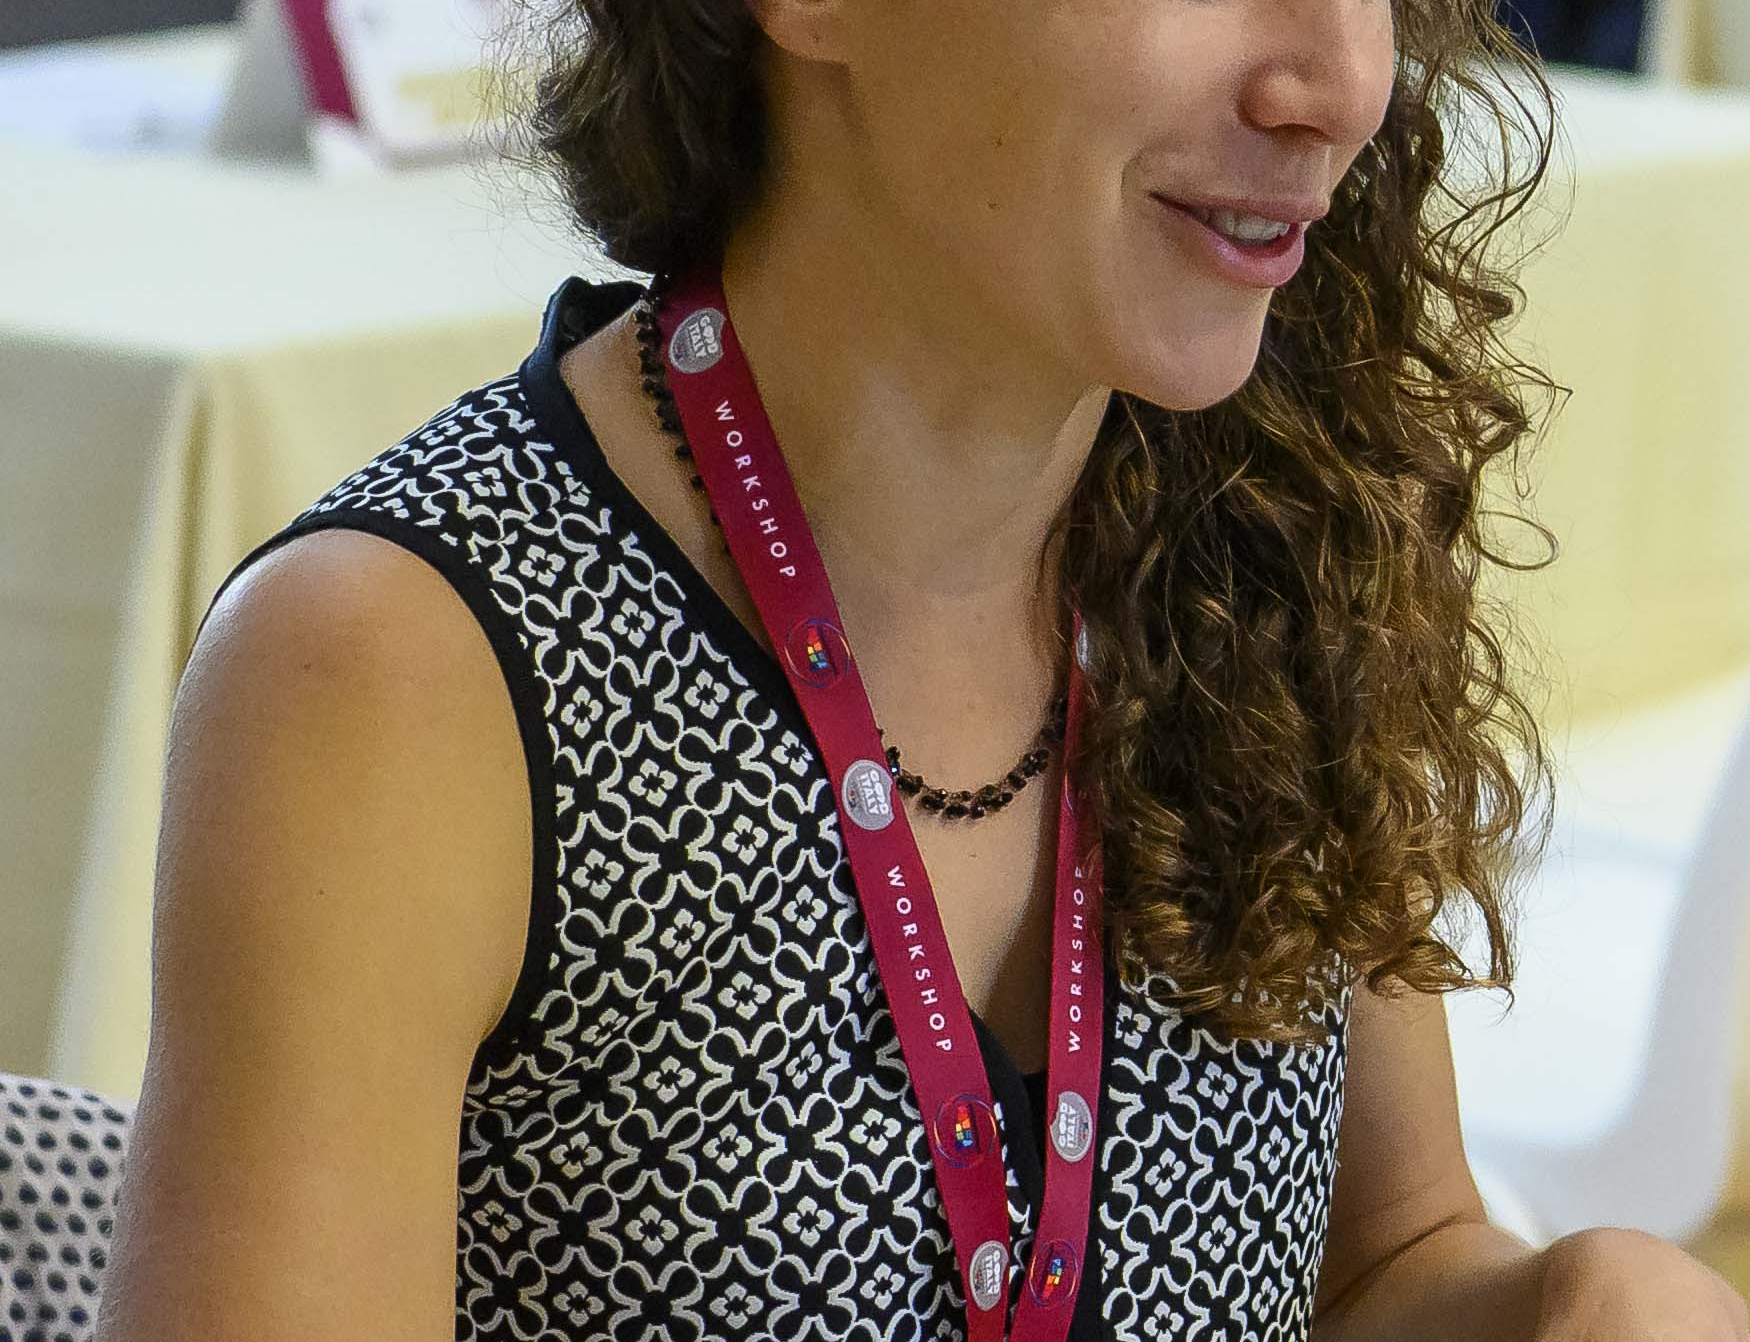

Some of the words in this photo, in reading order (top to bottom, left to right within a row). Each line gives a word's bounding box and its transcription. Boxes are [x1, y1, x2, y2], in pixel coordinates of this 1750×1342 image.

[688, 321, 707, 358] ITALY
[699, 315, 719, 355] GOOD
[715, 400, 796, 577] WORKSHOP
[860, 772, 880, 814] ITALY
[869, 769, 889, 815] GOOD
[887, 865, 953, 1052] WORKSHOP
